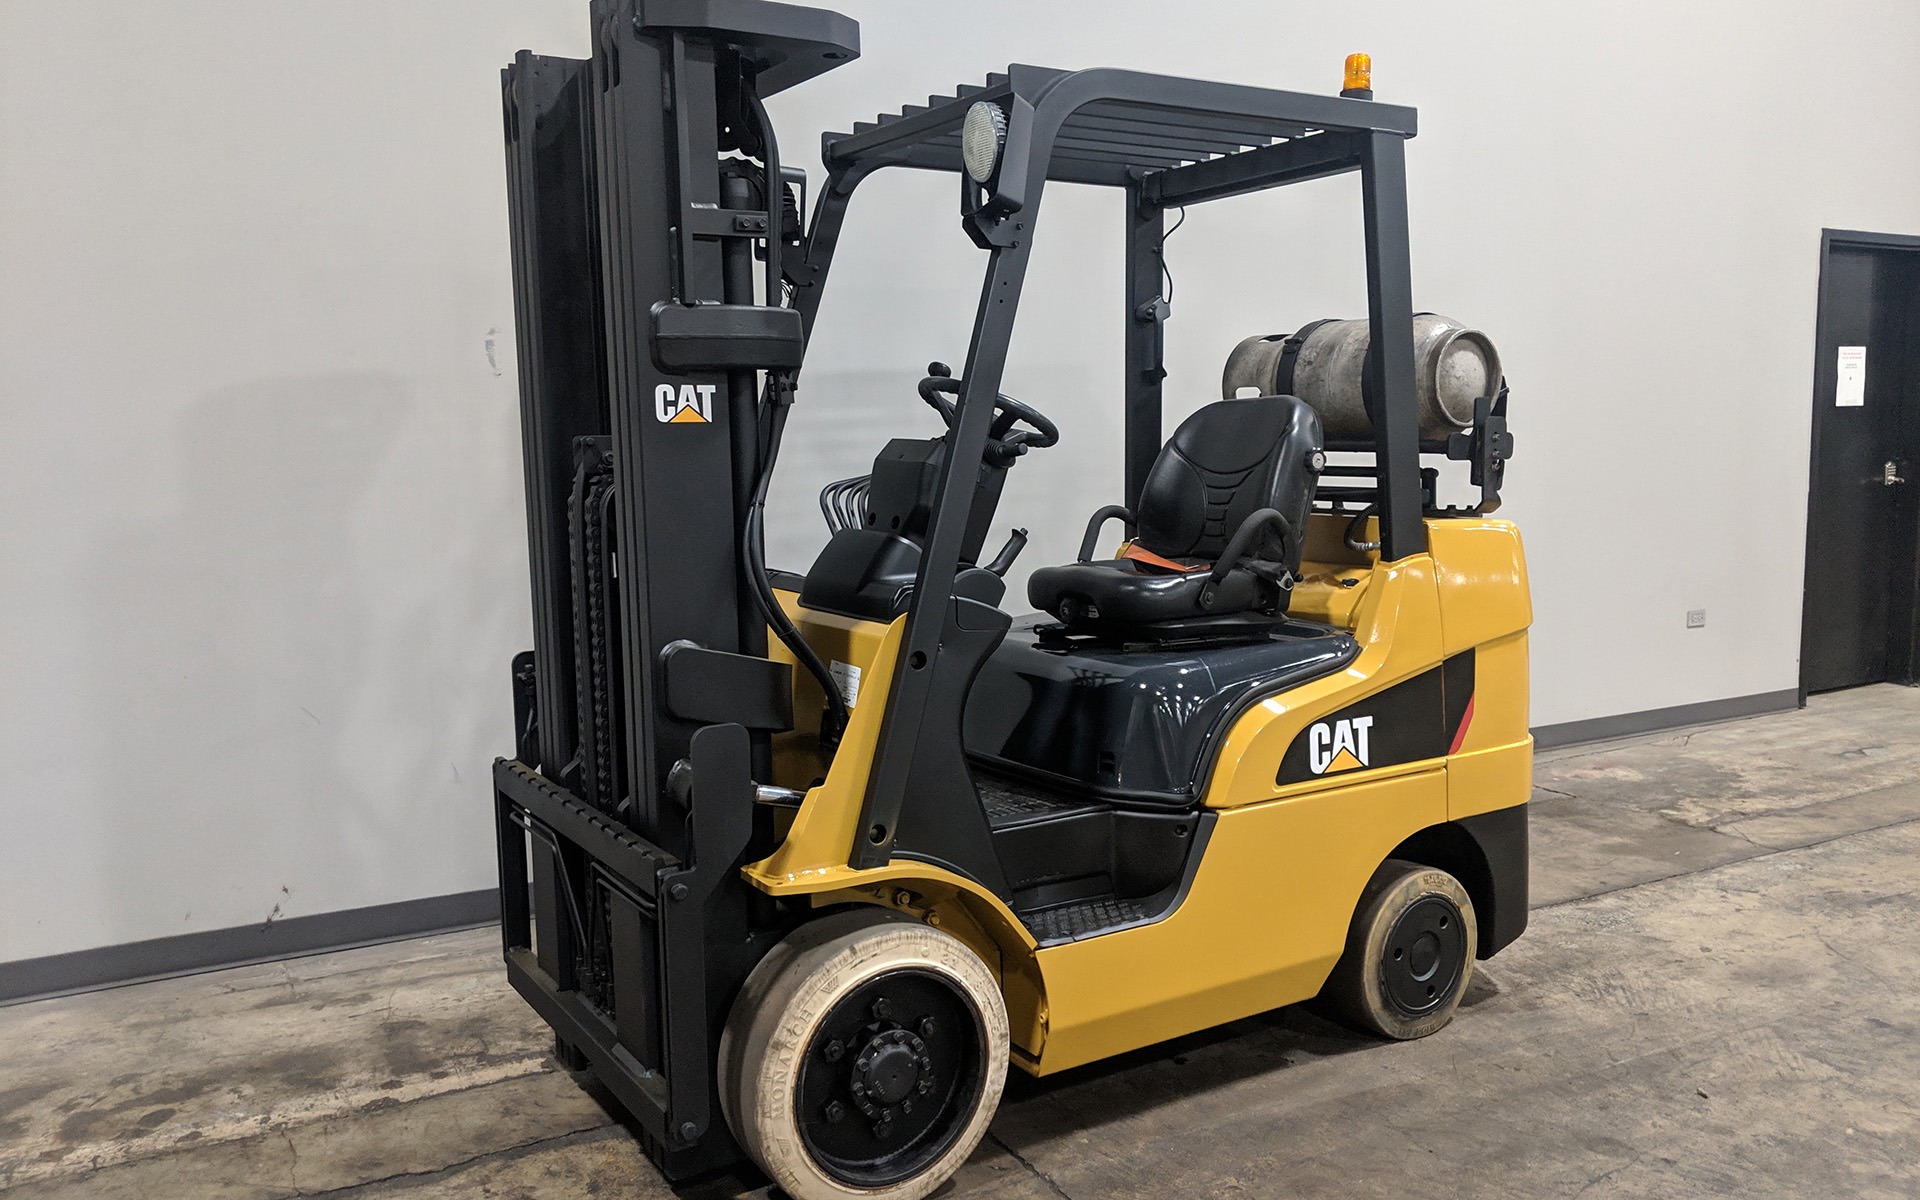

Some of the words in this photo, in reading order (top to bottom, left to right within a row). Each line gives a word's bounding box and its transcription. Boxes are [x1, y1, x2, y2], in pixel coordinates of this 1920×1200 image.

[655, 384, 716, 423] CAT
[1309, 715, 1374, 775] CAT
[770, 1008, 816, 1120] MONARCH
